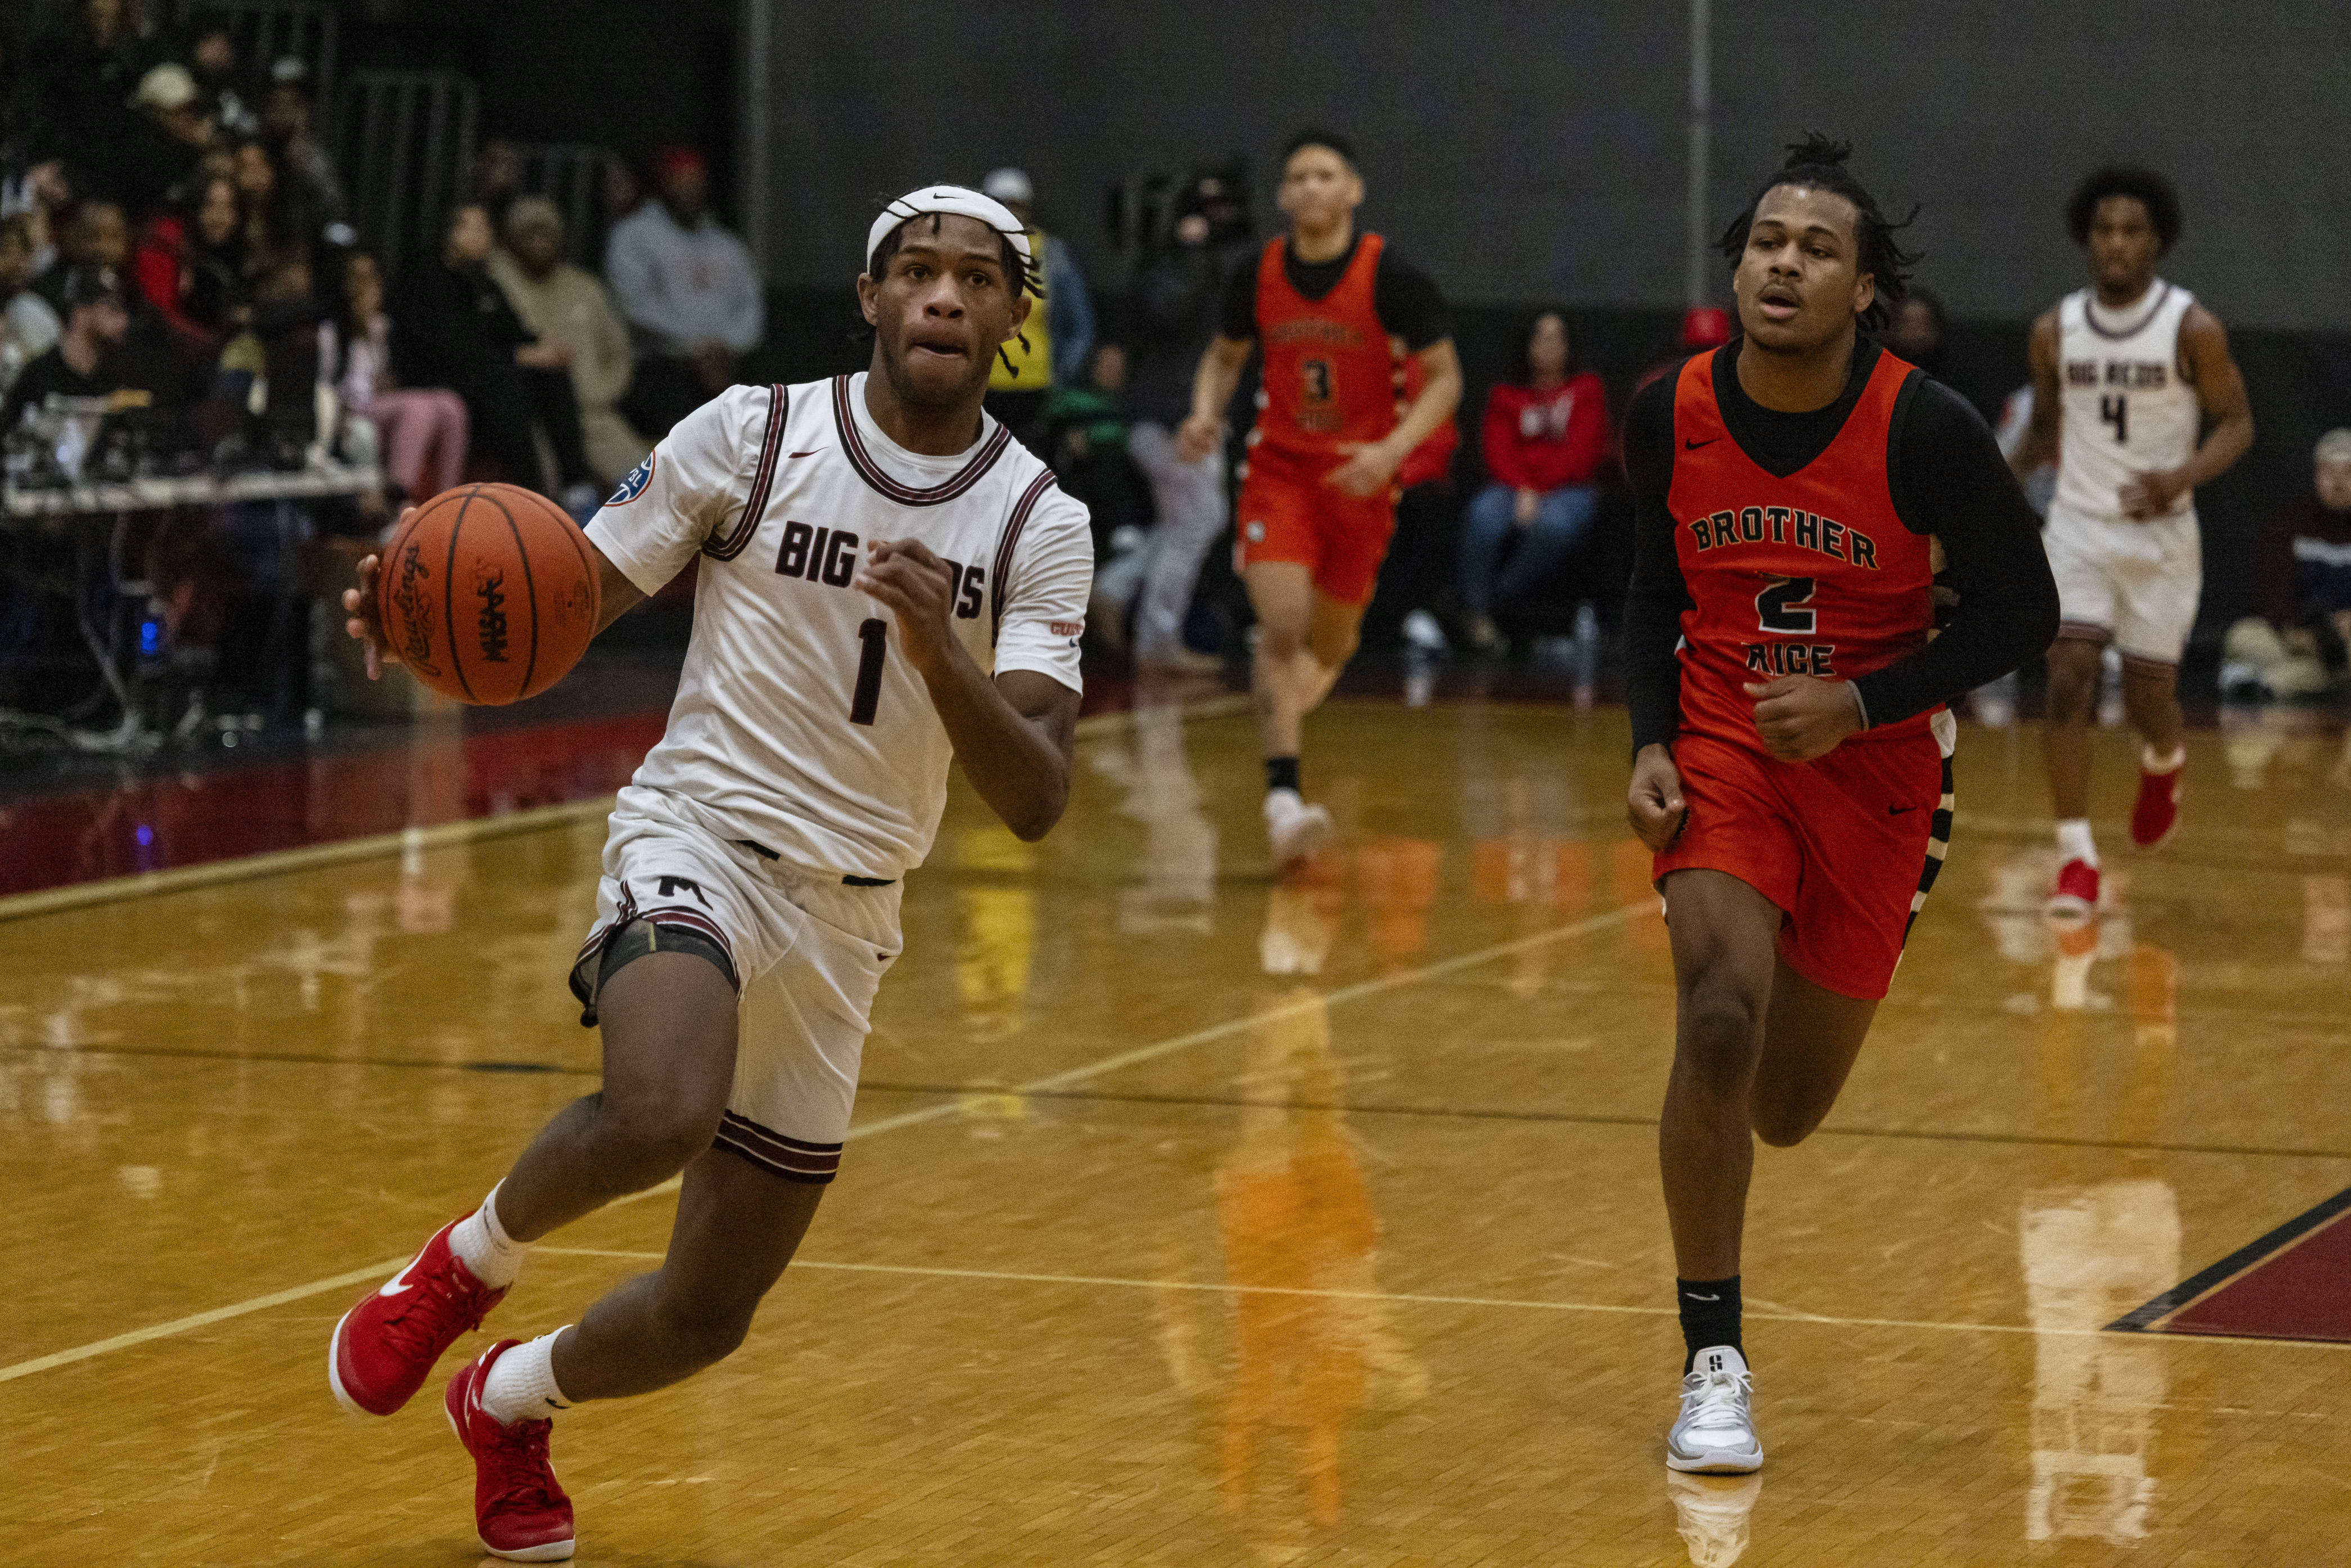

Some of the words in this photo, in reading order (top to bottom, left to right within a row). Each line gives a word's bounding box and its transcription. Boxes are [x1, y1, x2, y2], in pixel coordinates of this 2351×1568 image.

[2102, 395, 2126, 444] 4
[775, 520, 859, 588] BIG
[1688, 506, 1880, 570] BROTHER
[1755, 571, 1817, 635] 2
[849, 618, 888, 727] 1
[1741, 642, 1837, 677] RICE
